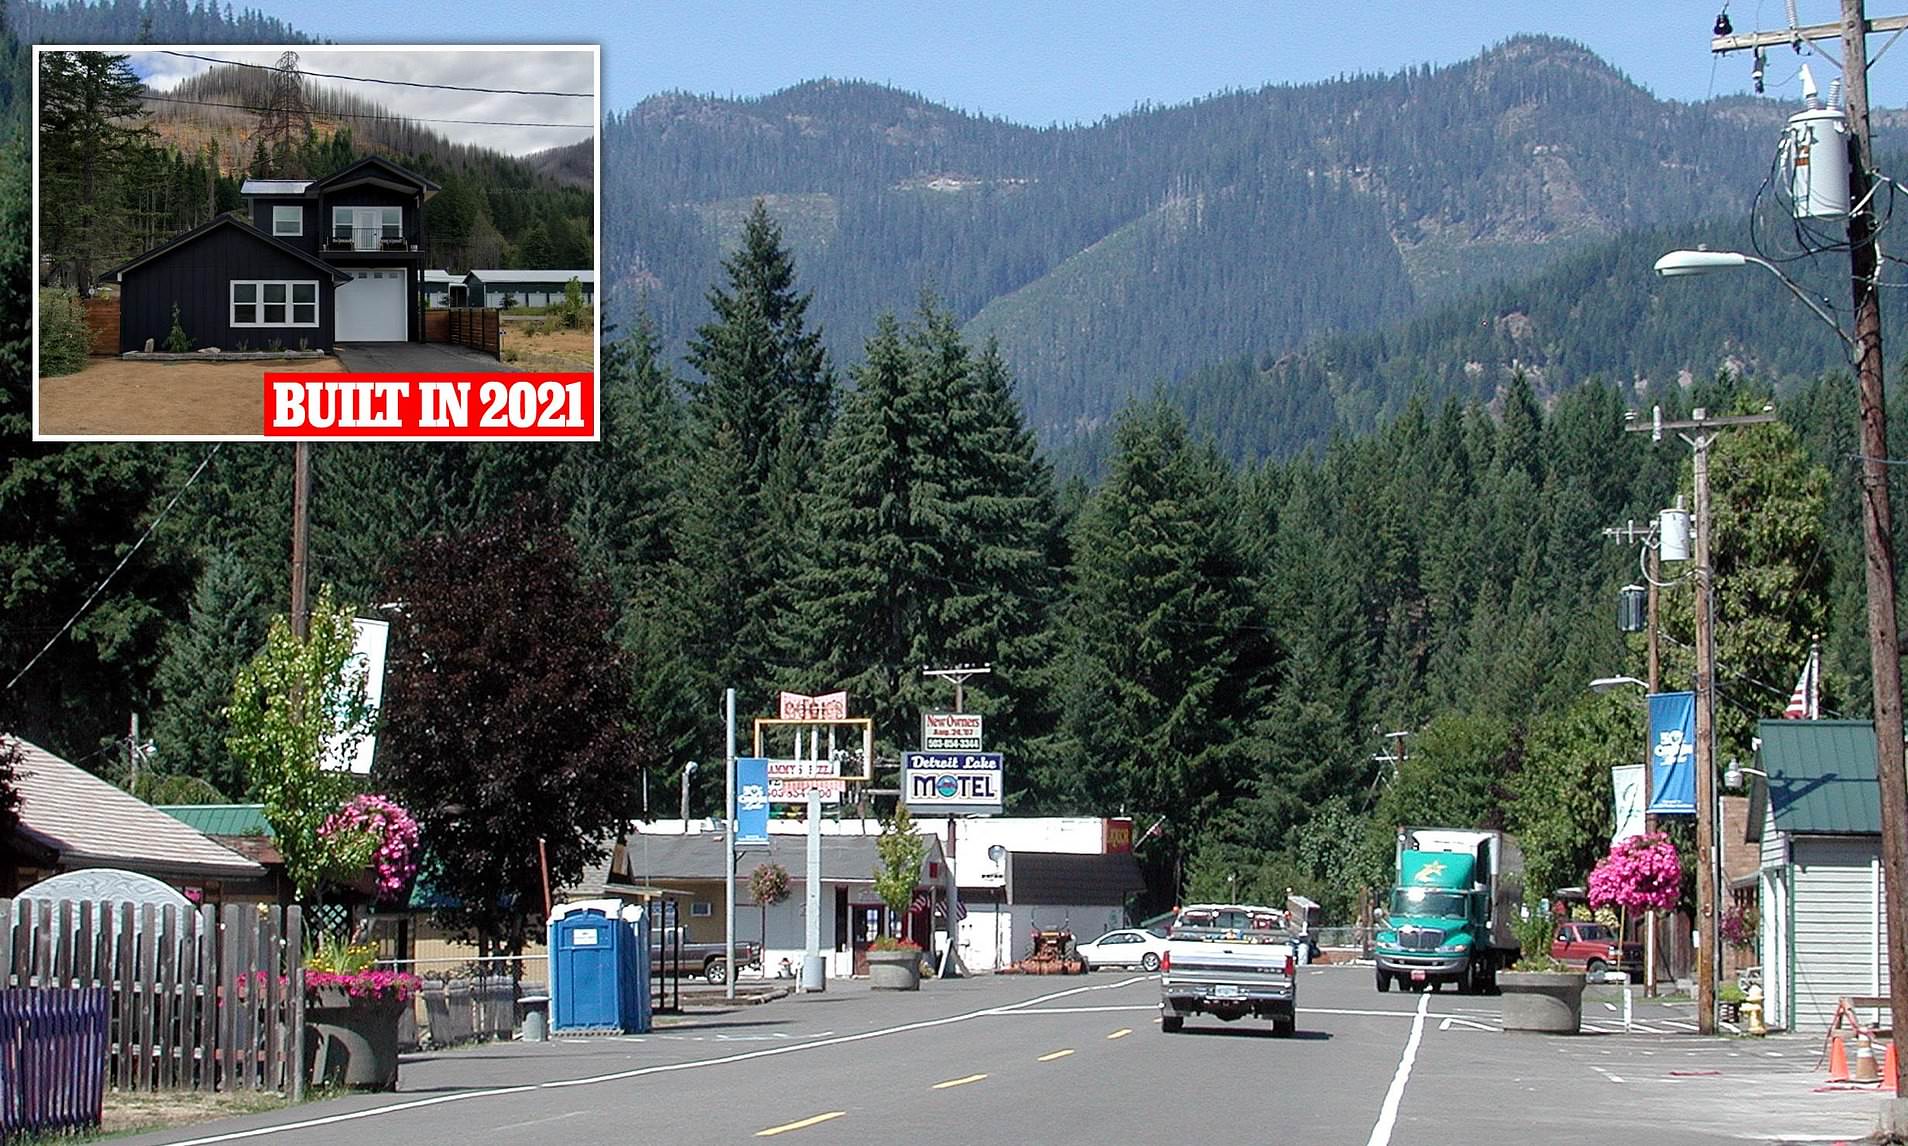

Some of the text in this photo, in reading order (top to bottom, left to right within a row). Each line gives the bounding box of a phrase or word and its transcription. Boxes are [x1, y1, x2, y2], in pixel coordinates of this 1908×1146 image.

[927, 714, 980, 728] New Owners
[911, 755, 997, 769] Detroit Lake
[912, 774, 996, 798] MOTEL
